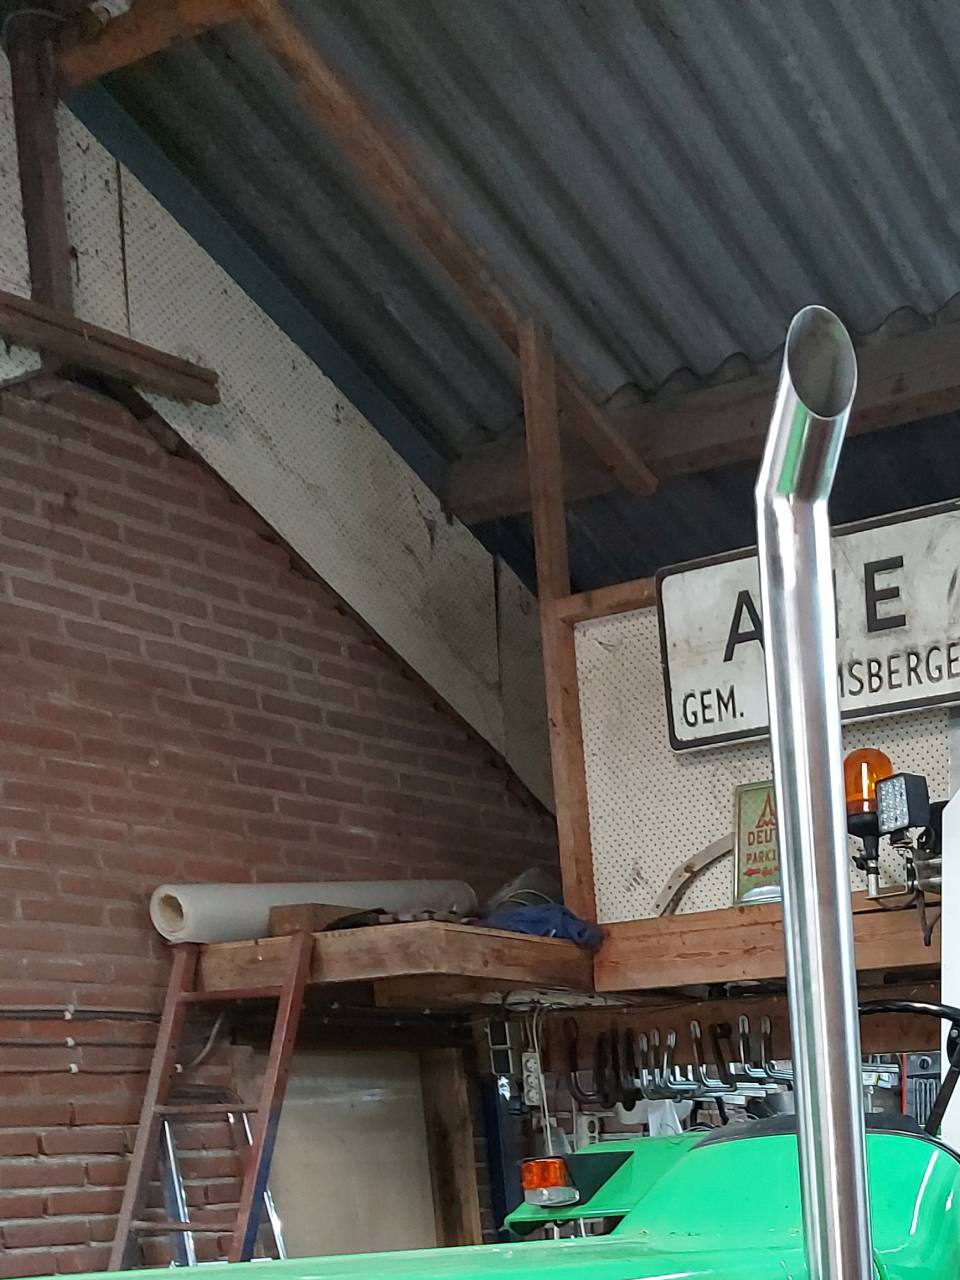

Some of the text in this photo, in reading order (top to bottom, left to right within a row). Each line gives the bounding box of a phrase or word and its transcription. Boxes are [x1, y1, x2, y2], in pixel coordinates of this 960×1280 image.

[723, 555, 907, 662] AE
[682, 685, 745, 727] GEM.
[747, 828, 776, 847] DEU
[746, 848, 777, 864] PARKI
